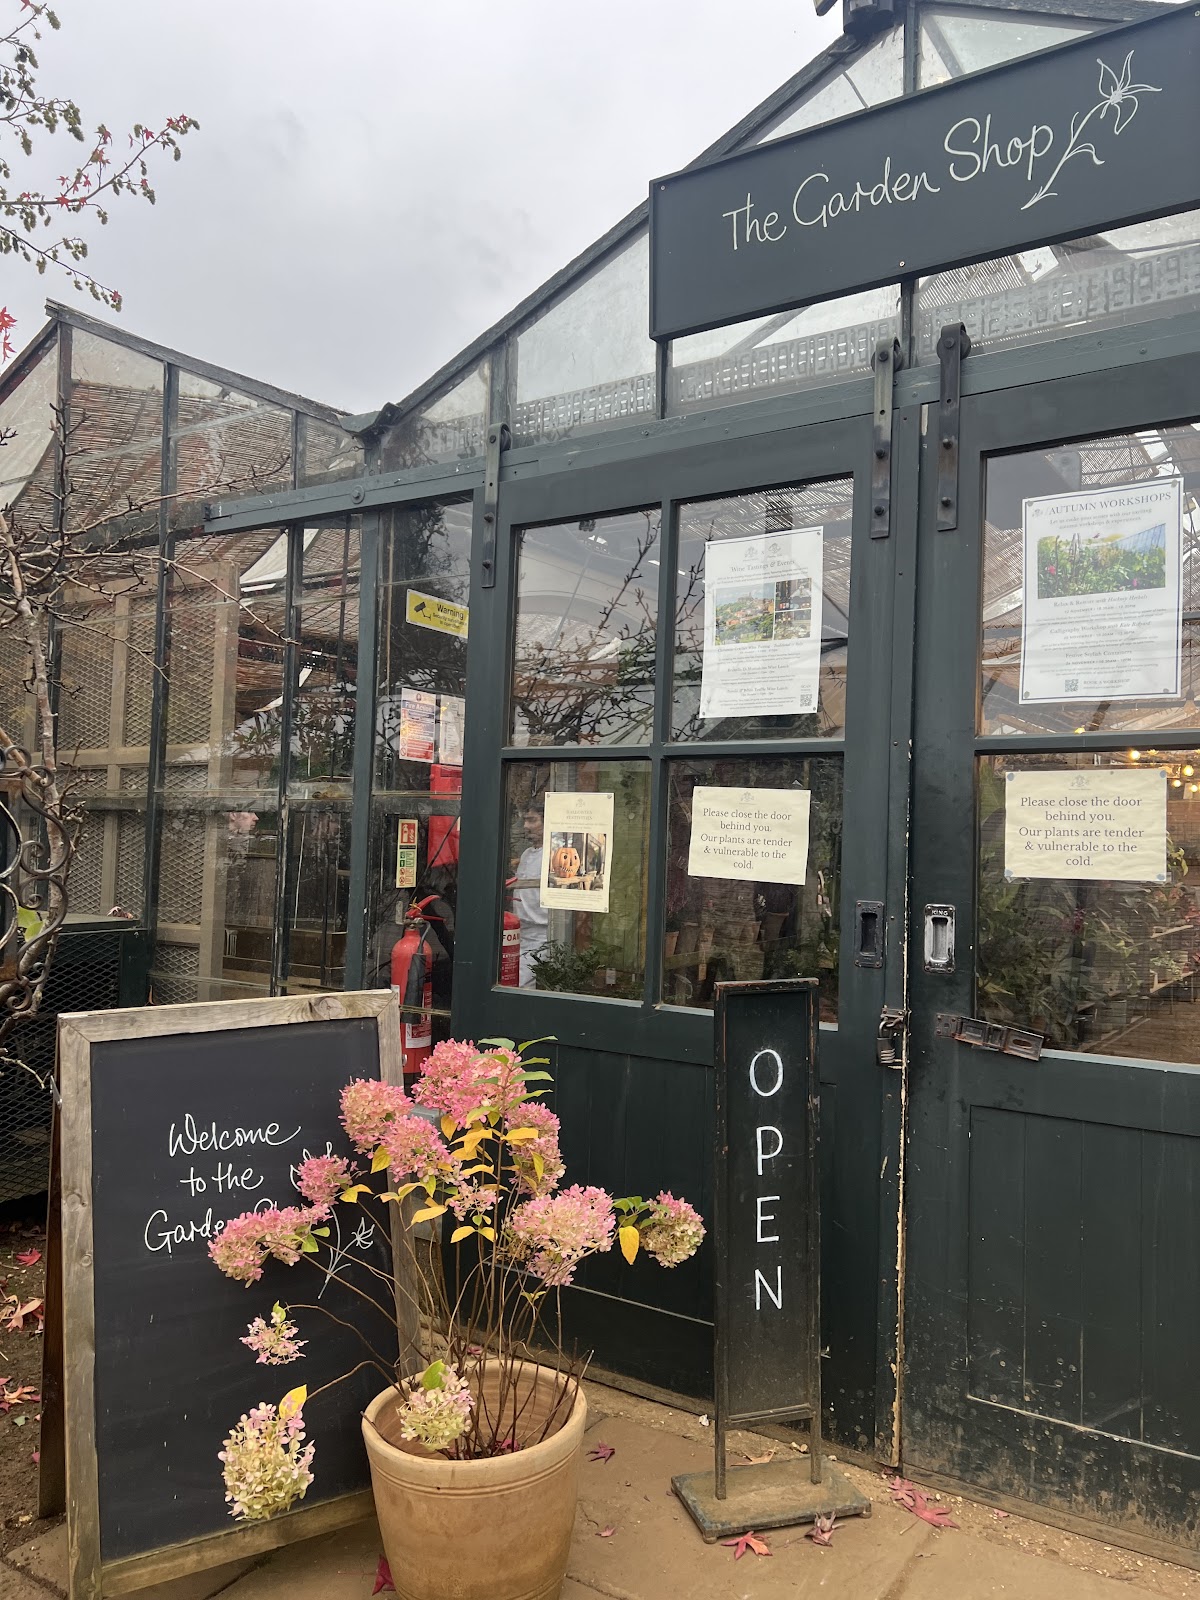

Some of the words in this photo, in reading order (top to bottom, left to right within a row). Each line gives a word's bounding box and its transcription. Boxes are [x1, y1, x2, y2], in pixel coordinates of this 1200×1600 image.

[722, 192, 787, 251] The
[793, 157, 940, 228] Garden
[944, 114, 1054, 181] Shop
[1049, 502, 1097, 516] AUTUMN
[1100, 491, 1172, 510] WORKSHOPS
[747, 563, 769, 571] Tastings
[769, 560, 776, 568] &
[777, 559, 795, 567] Events
[437, 603, 464, 621] Warning
[1050, 626, 1080, 635] Calligraphy
[1081, 624, 1107, 633] Workshop
[405, 701, 415, 709] Fire
[1020, 797, 1056, 807] Please
[1058, 796, 1088, 807] close
[1091, 796, 1110, 807] the
[1113, 796, 1143, 807] door
[703, 808, 729, 818] Please
[731, 808, 752, 819] close
[754, 810, 769, 820] the
[770, 811, 792, 821] door
[1045, 811, 1086, 822] behind
[1089, 812, 1115, 823] you.
[720, 821, 751, 831] behind
[753, 824, 772, 833] you.
[1018, 827, 1042, 837] Our
[1044, 827, 1080, 839] plants
[1082, 830, 1101, 838] are
[1104, 827, 1145, 838] tender
[700, 833, 717, 842] Our
[719, 835, 745, 845] plants
[746, 837, 762, 845] are
[763, 837, 793, 847] tender
[703, 846, 711, 854] &
[713, 847, 759, 857] vulnerable
[761, 850, 770, 858] to
[772, 851, 787, 860] the
[1024, 841, 1034, 851] &
[1037, 842, 1099, 852] vulnerable
[1102, 843, 1115, 852] to
[1117, 842, 1138, 853] the
[733, 860, 754, 870] cold.
[1065, 855, 1094, 867] cold.
[168, 1113, 302, 1157] Welcome
[180, 1166, 207, 1197] to
[211, 1162, 264, 1194] the
[748, 1048, 785, 1311] OPEN
[144, 1207, 226, 1254] Garde
